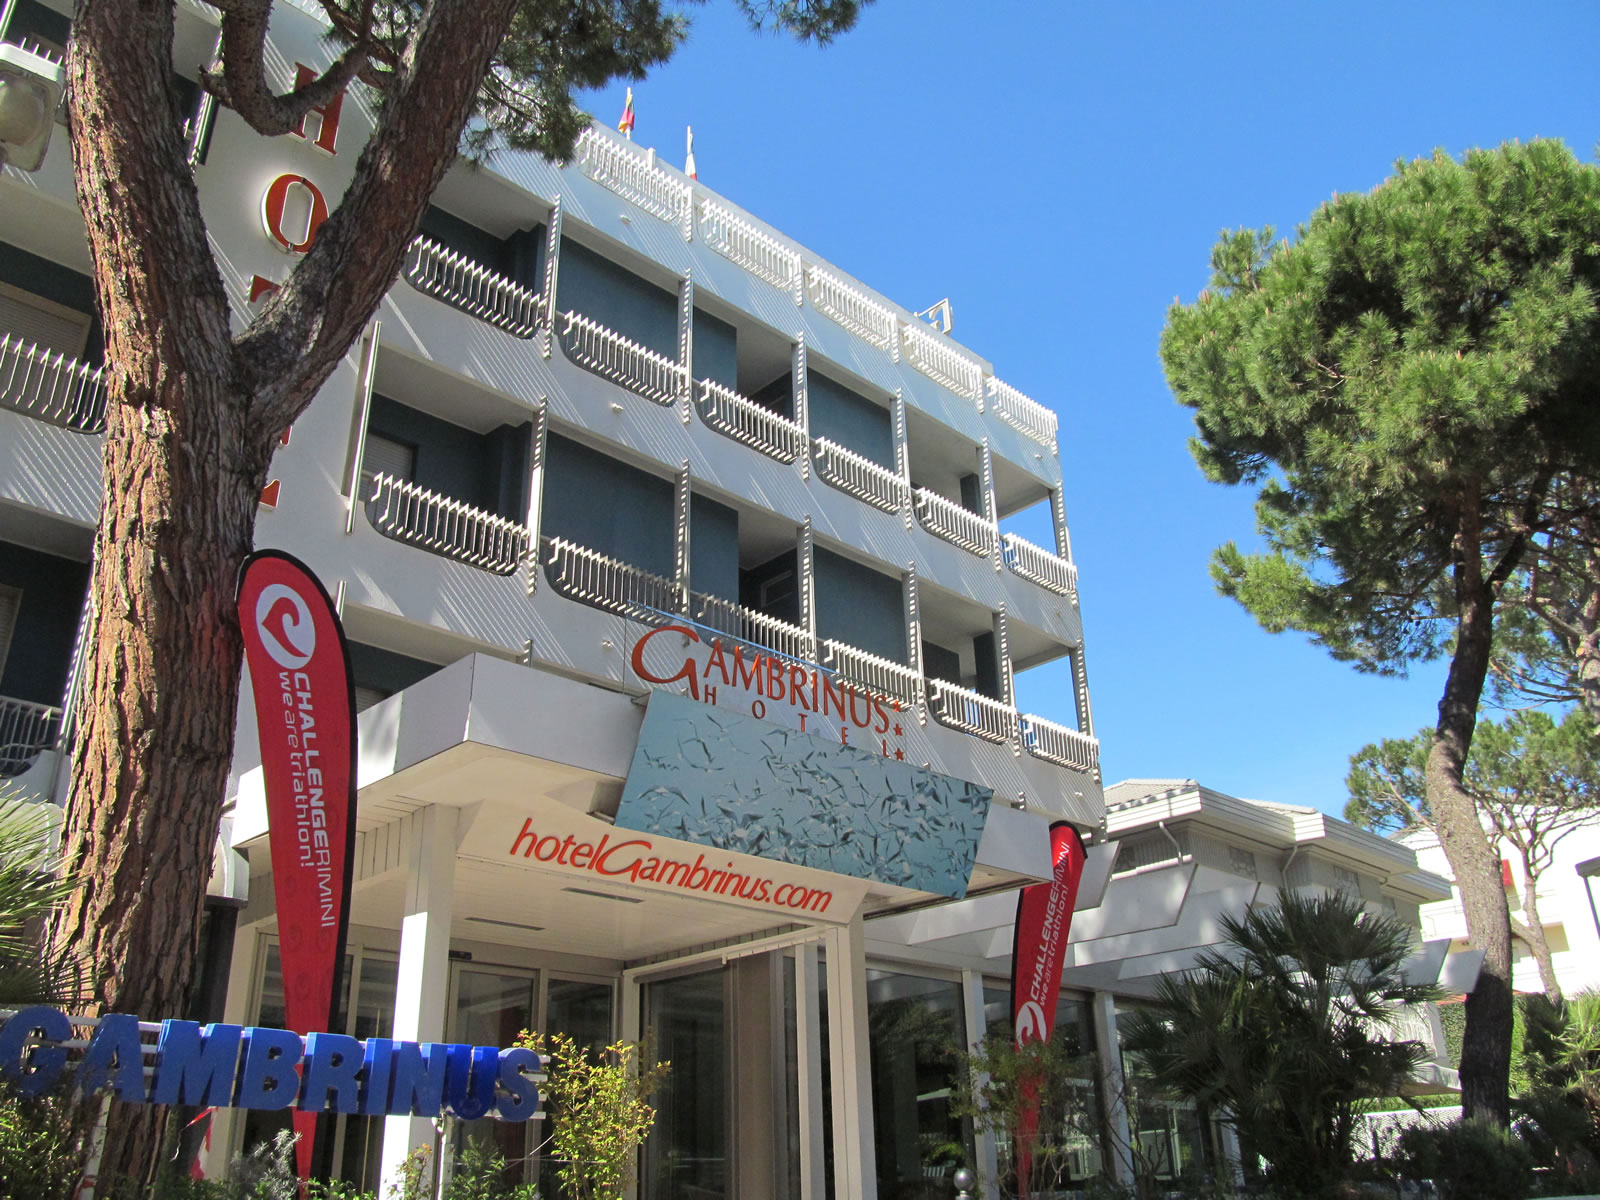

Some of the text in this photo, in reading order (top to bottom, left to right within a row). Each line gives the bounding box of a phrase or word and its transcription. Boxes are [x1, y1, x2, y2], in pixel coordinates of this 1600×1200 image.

[631, 625, 890, 734] GAMBRINUS
[704, 683, 890, 758] HOTEL
[279, 671, 315, 868] we are triathlon!
[509, 817, 833, 913] hotelGambrinus.com
[0, 1005, 542, 1121] GAMBRINUS
